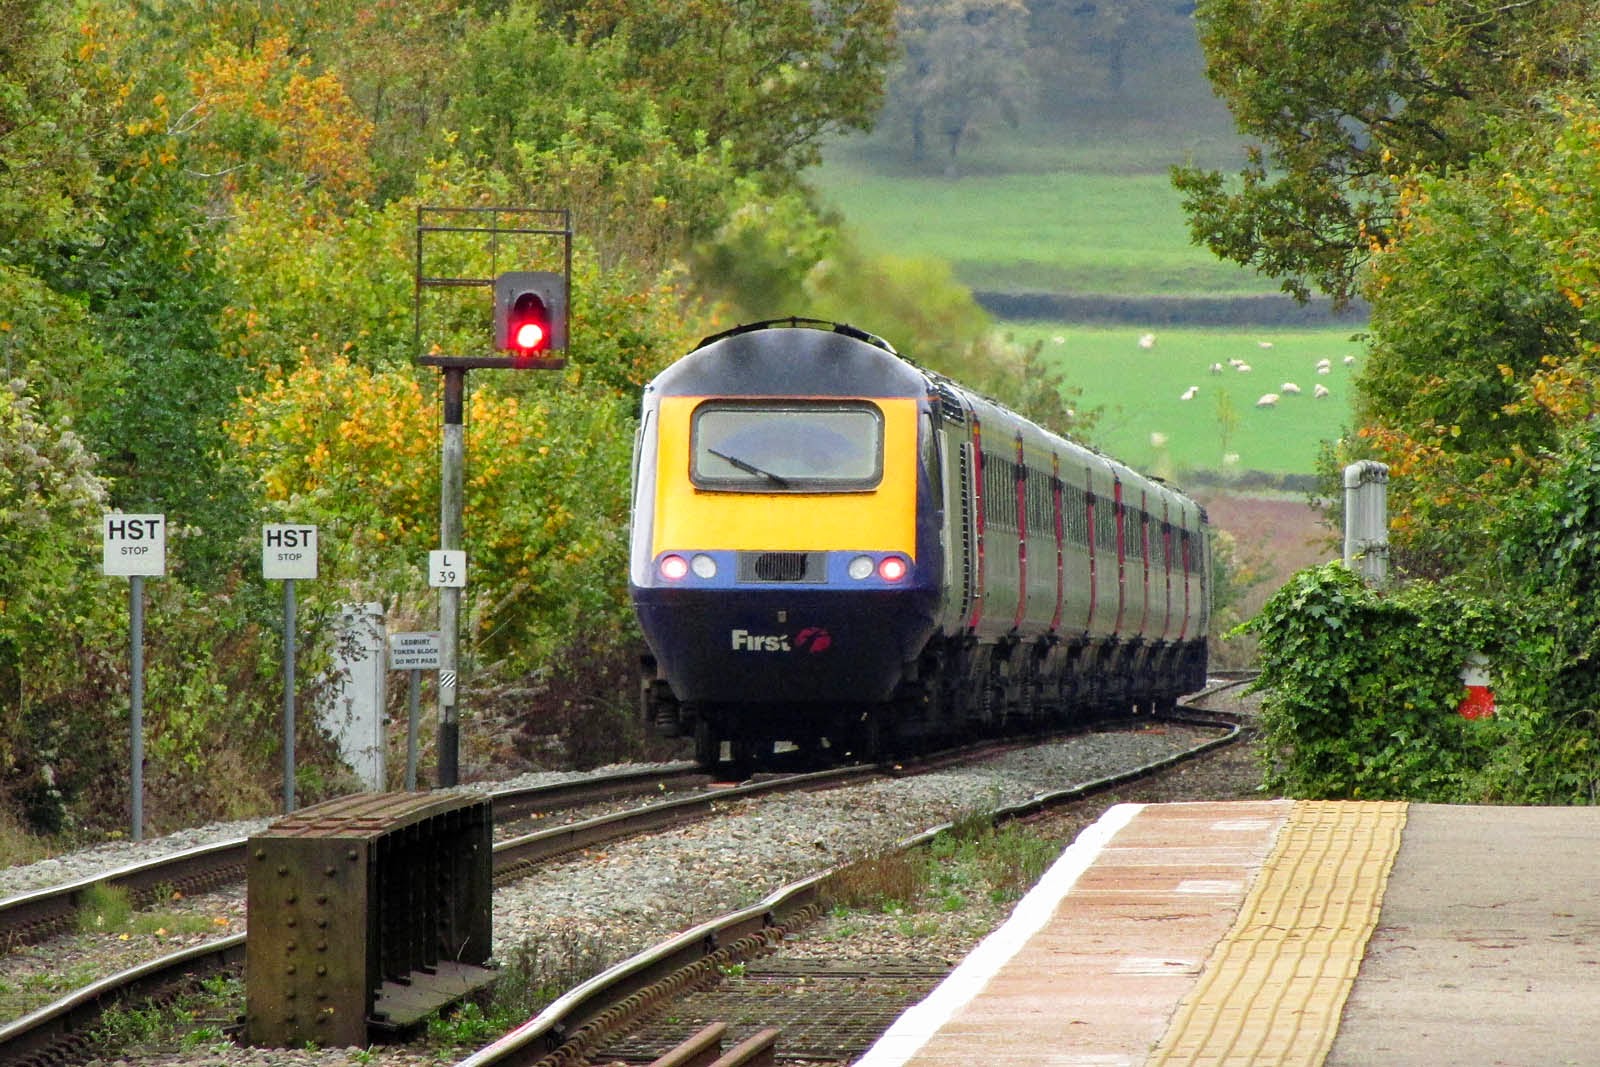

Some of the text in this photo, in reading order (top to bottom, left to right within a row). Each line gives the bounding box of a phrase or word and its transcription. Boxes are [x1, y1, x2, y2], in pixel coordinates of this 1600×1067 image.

[109, 519, 160, 540] HST
[266, 529, 313, 548] HST
[120, 546, 149, 555] STOP
[278, 553, 302, 561] STOP
[443, 555, 451, 566] L
[439, 571, 456, 583] 39
[731, 629, 791, 651] First
